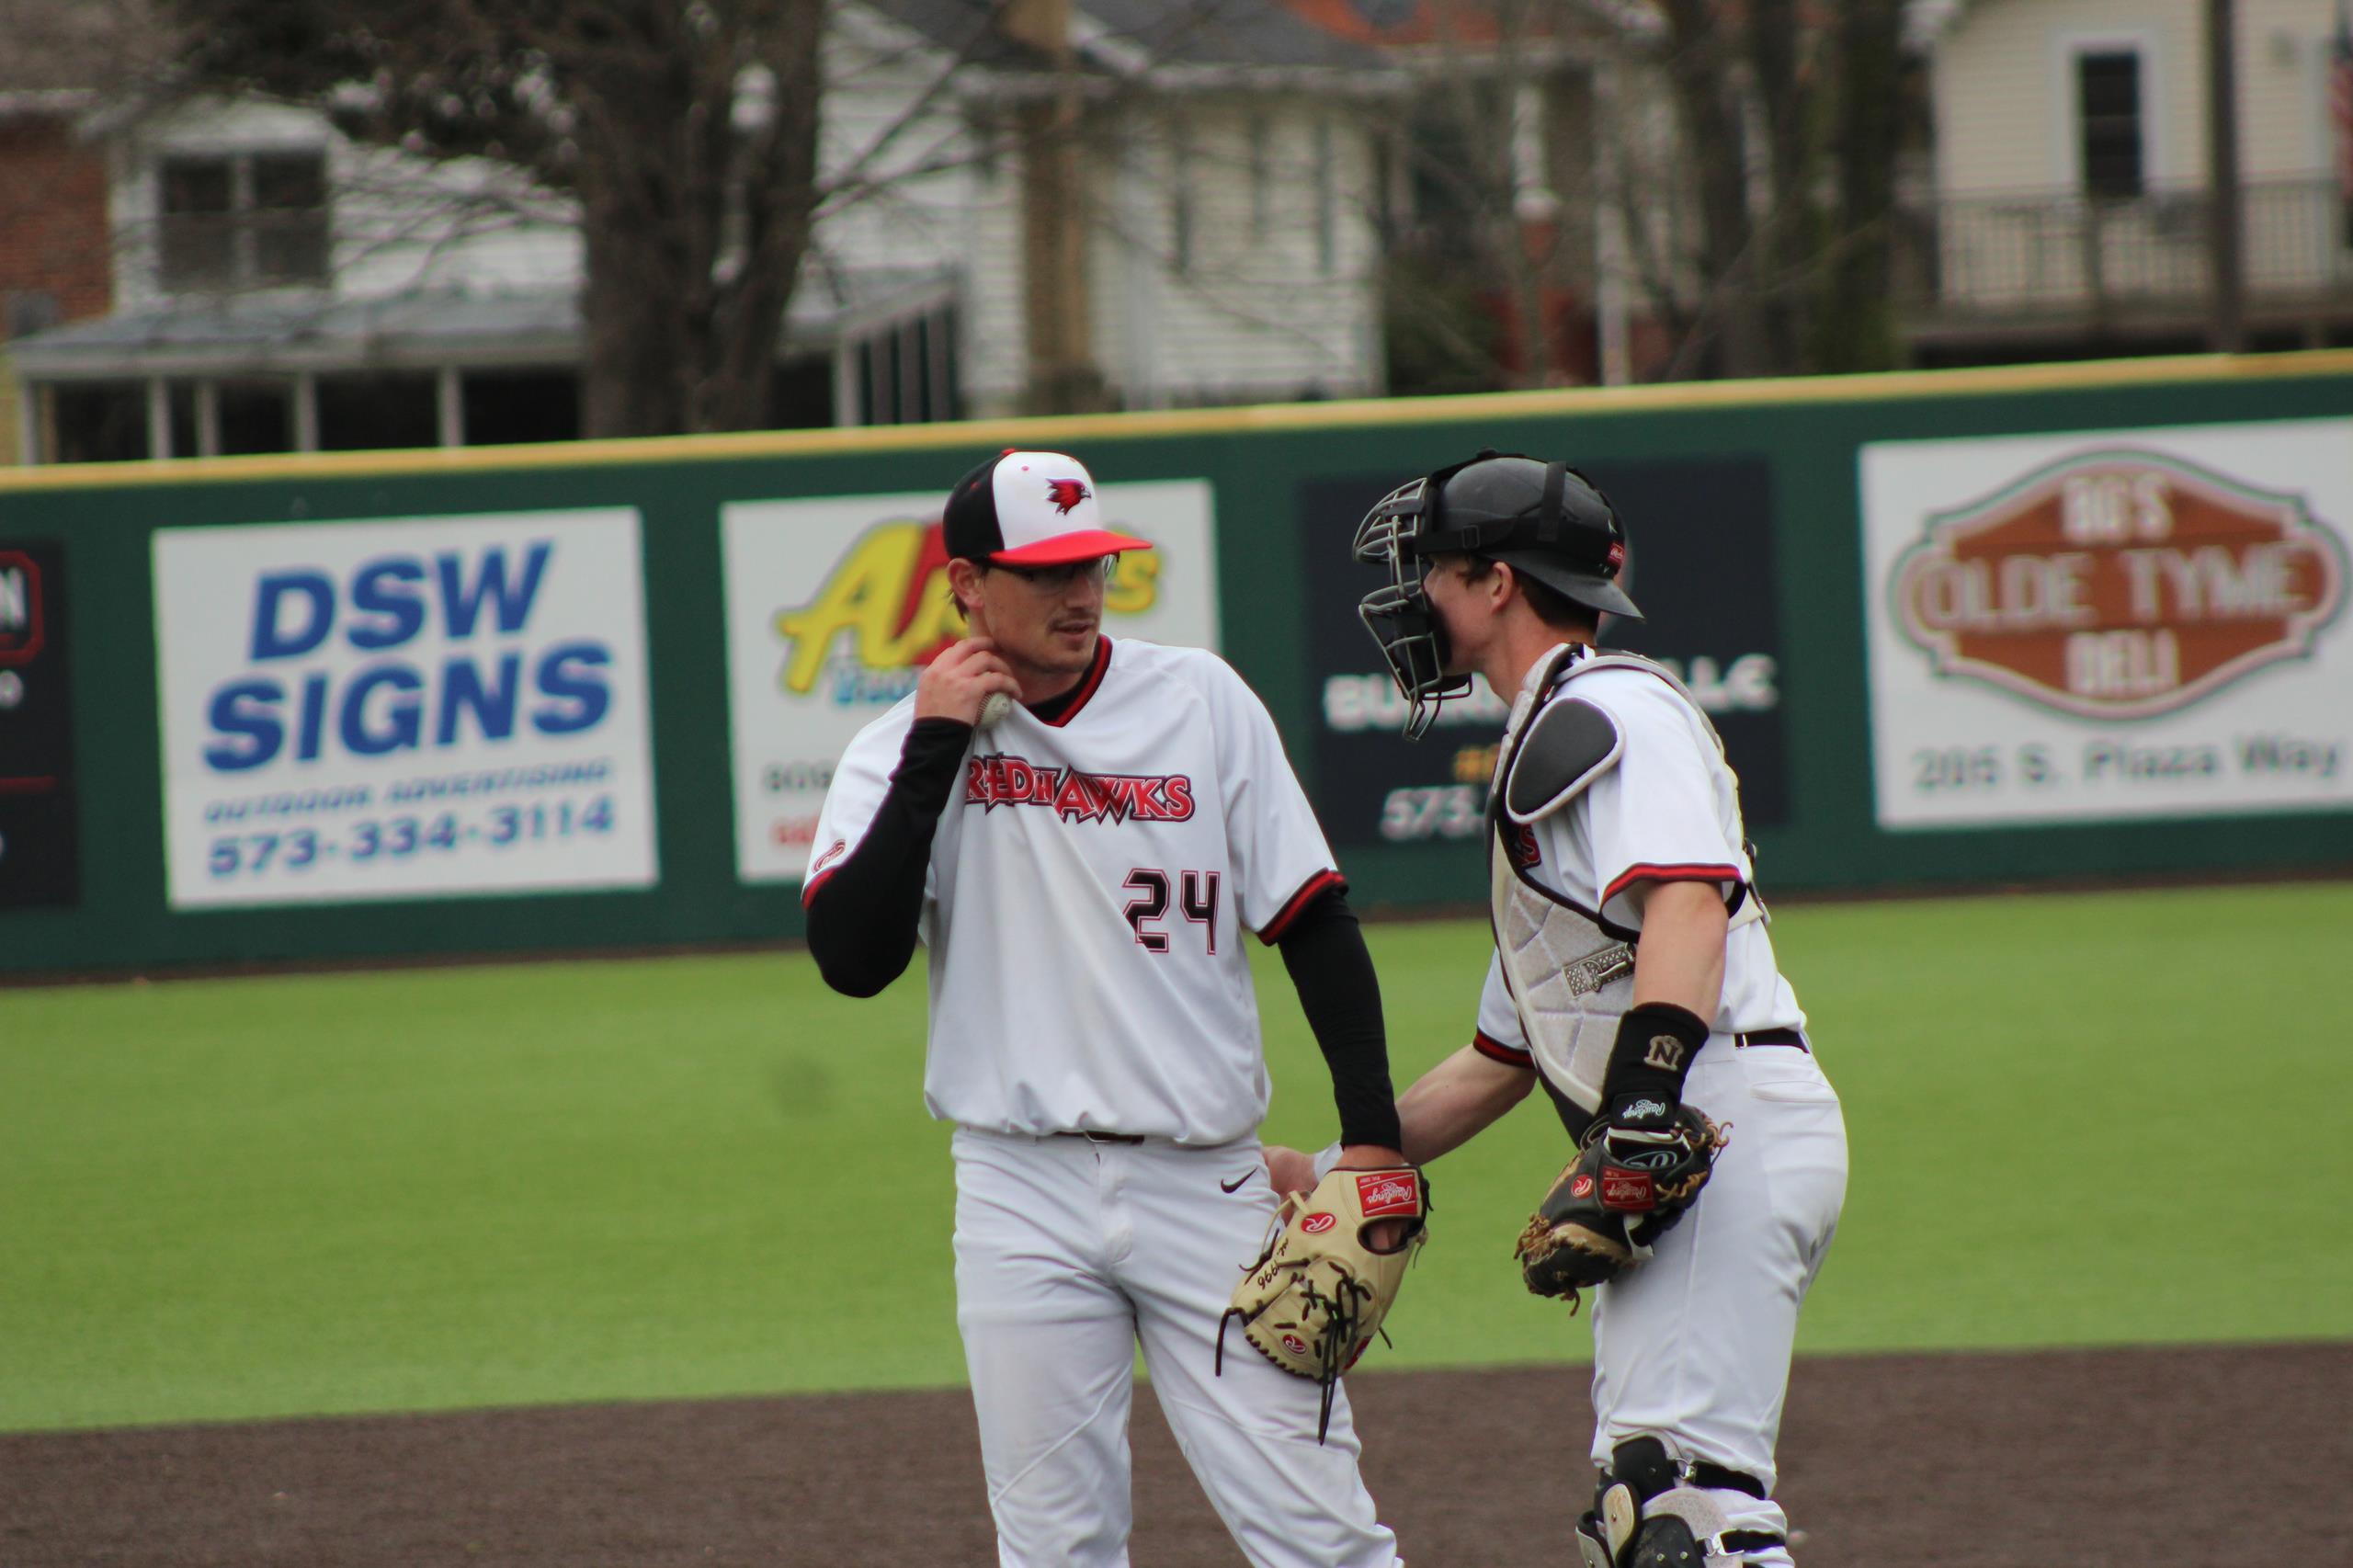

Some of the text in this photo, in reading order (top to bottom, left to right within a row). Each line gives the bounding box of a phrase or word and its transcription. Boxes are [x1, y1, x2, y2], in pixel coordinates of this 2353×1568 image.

[248, 540, 554, 664] DSW
[1917, 542, 2307, 631] OLDE TYME
[2065, 630, 2180, 696] DELI
[204, 641, 614, 773] SIGNS
[965, 752, 1196, 826] REDHAWKS
[2082, 739, 2220, 781] Plaza
[2234, 733, 2340, 779] Way
[205, 761, 613, 824] OUTDOOR ADVERTISING
[209, 795, 613, 878] 573-334-3114
[1122, 868, 1221, 956] 24
[1622, 1100, 1665, 1119] Rawlings
[1367, 1183, 1413, 1204] Rawlings
[1257, 1259, 1280, 1290] 1996
